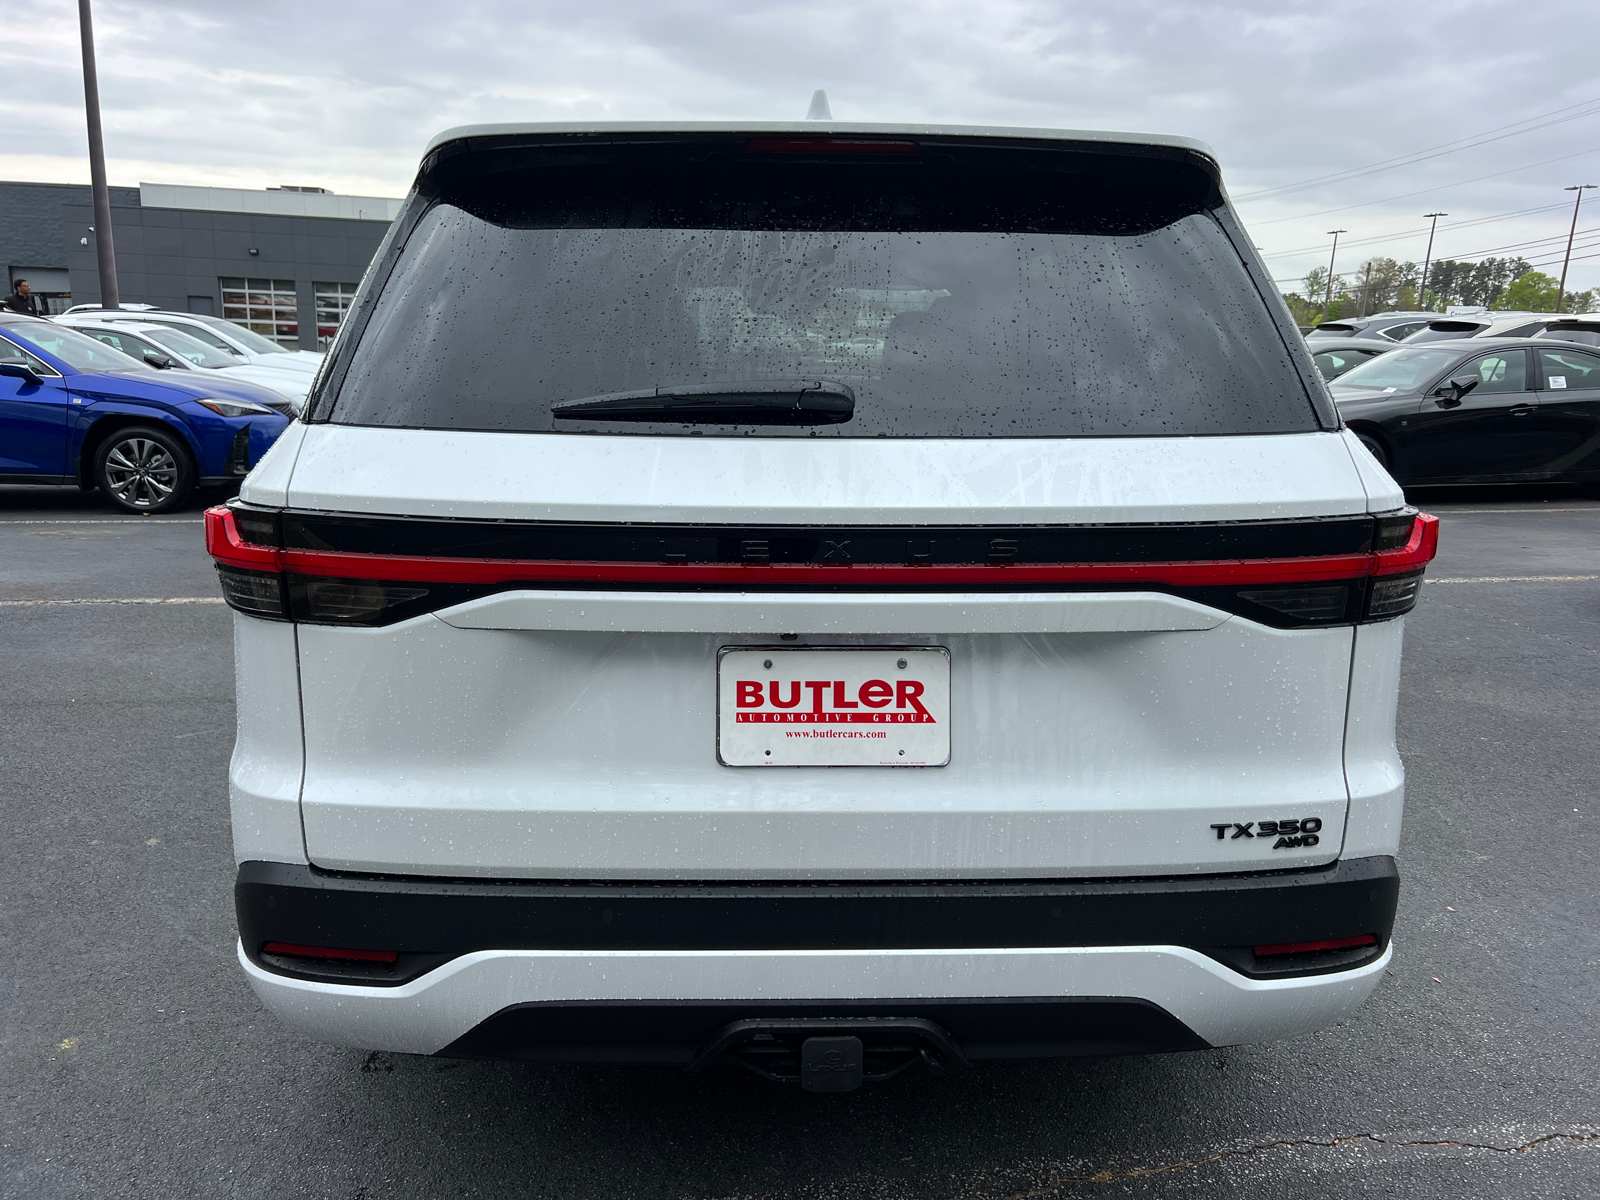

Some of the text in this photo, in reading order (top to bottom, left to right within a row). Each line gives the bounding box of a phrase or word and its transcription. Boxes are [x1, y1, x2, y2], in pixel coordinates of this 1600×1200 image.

[658, 538, 1019, 559] LEXUS
[736, 712, 930, 723] AUTOMOTIVE GROUP
[785, 729, 887, 739] www.butlercars.com
[1272, 833, 1320, 850] AWD
[808, 1063, 857, 1073] LEXUS
